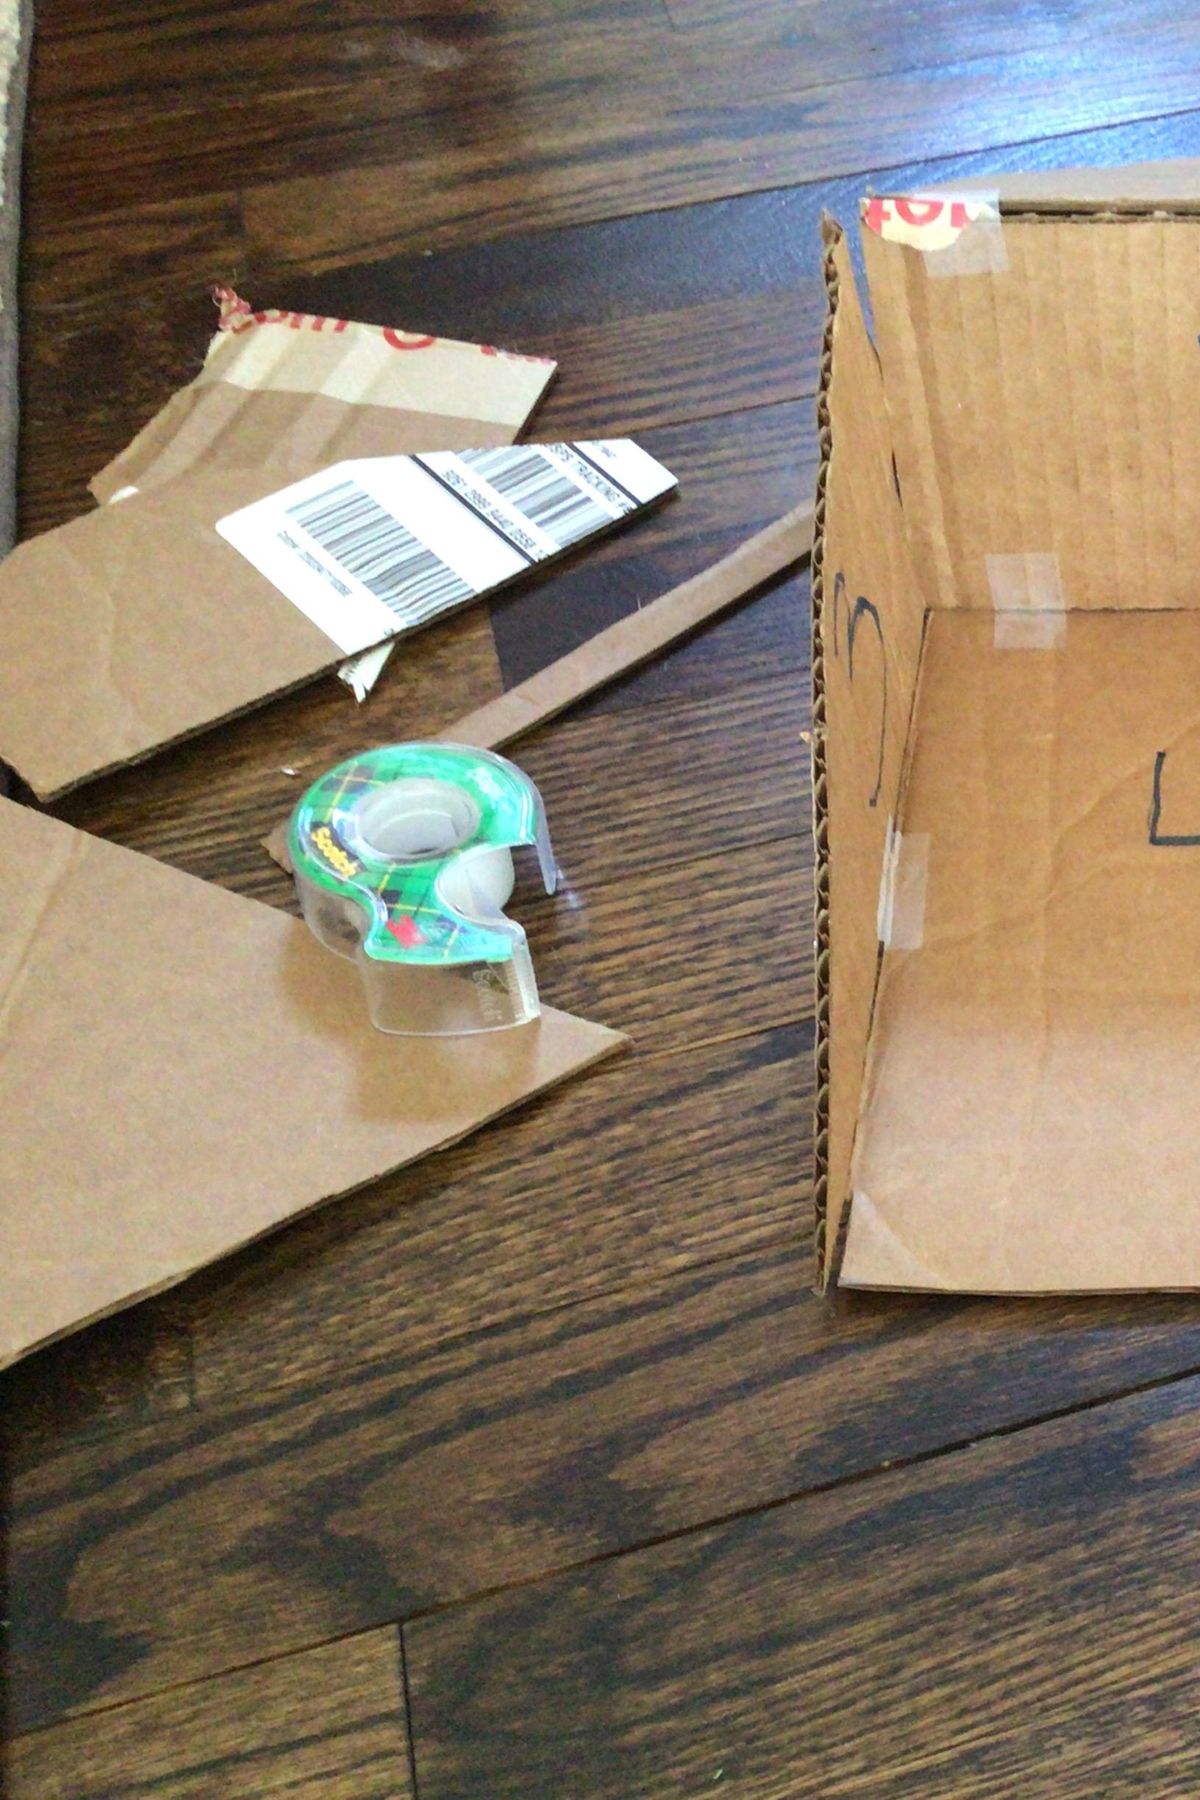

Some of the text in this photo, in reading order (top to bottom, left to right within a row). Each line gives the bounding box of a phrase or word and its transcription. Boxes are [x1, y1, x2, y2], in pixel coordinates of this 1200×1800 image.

[576, 461, 621, 502] TRACKING
[834, 572, 887, 808] 3
[311, 826, 358, 879] Scotch
